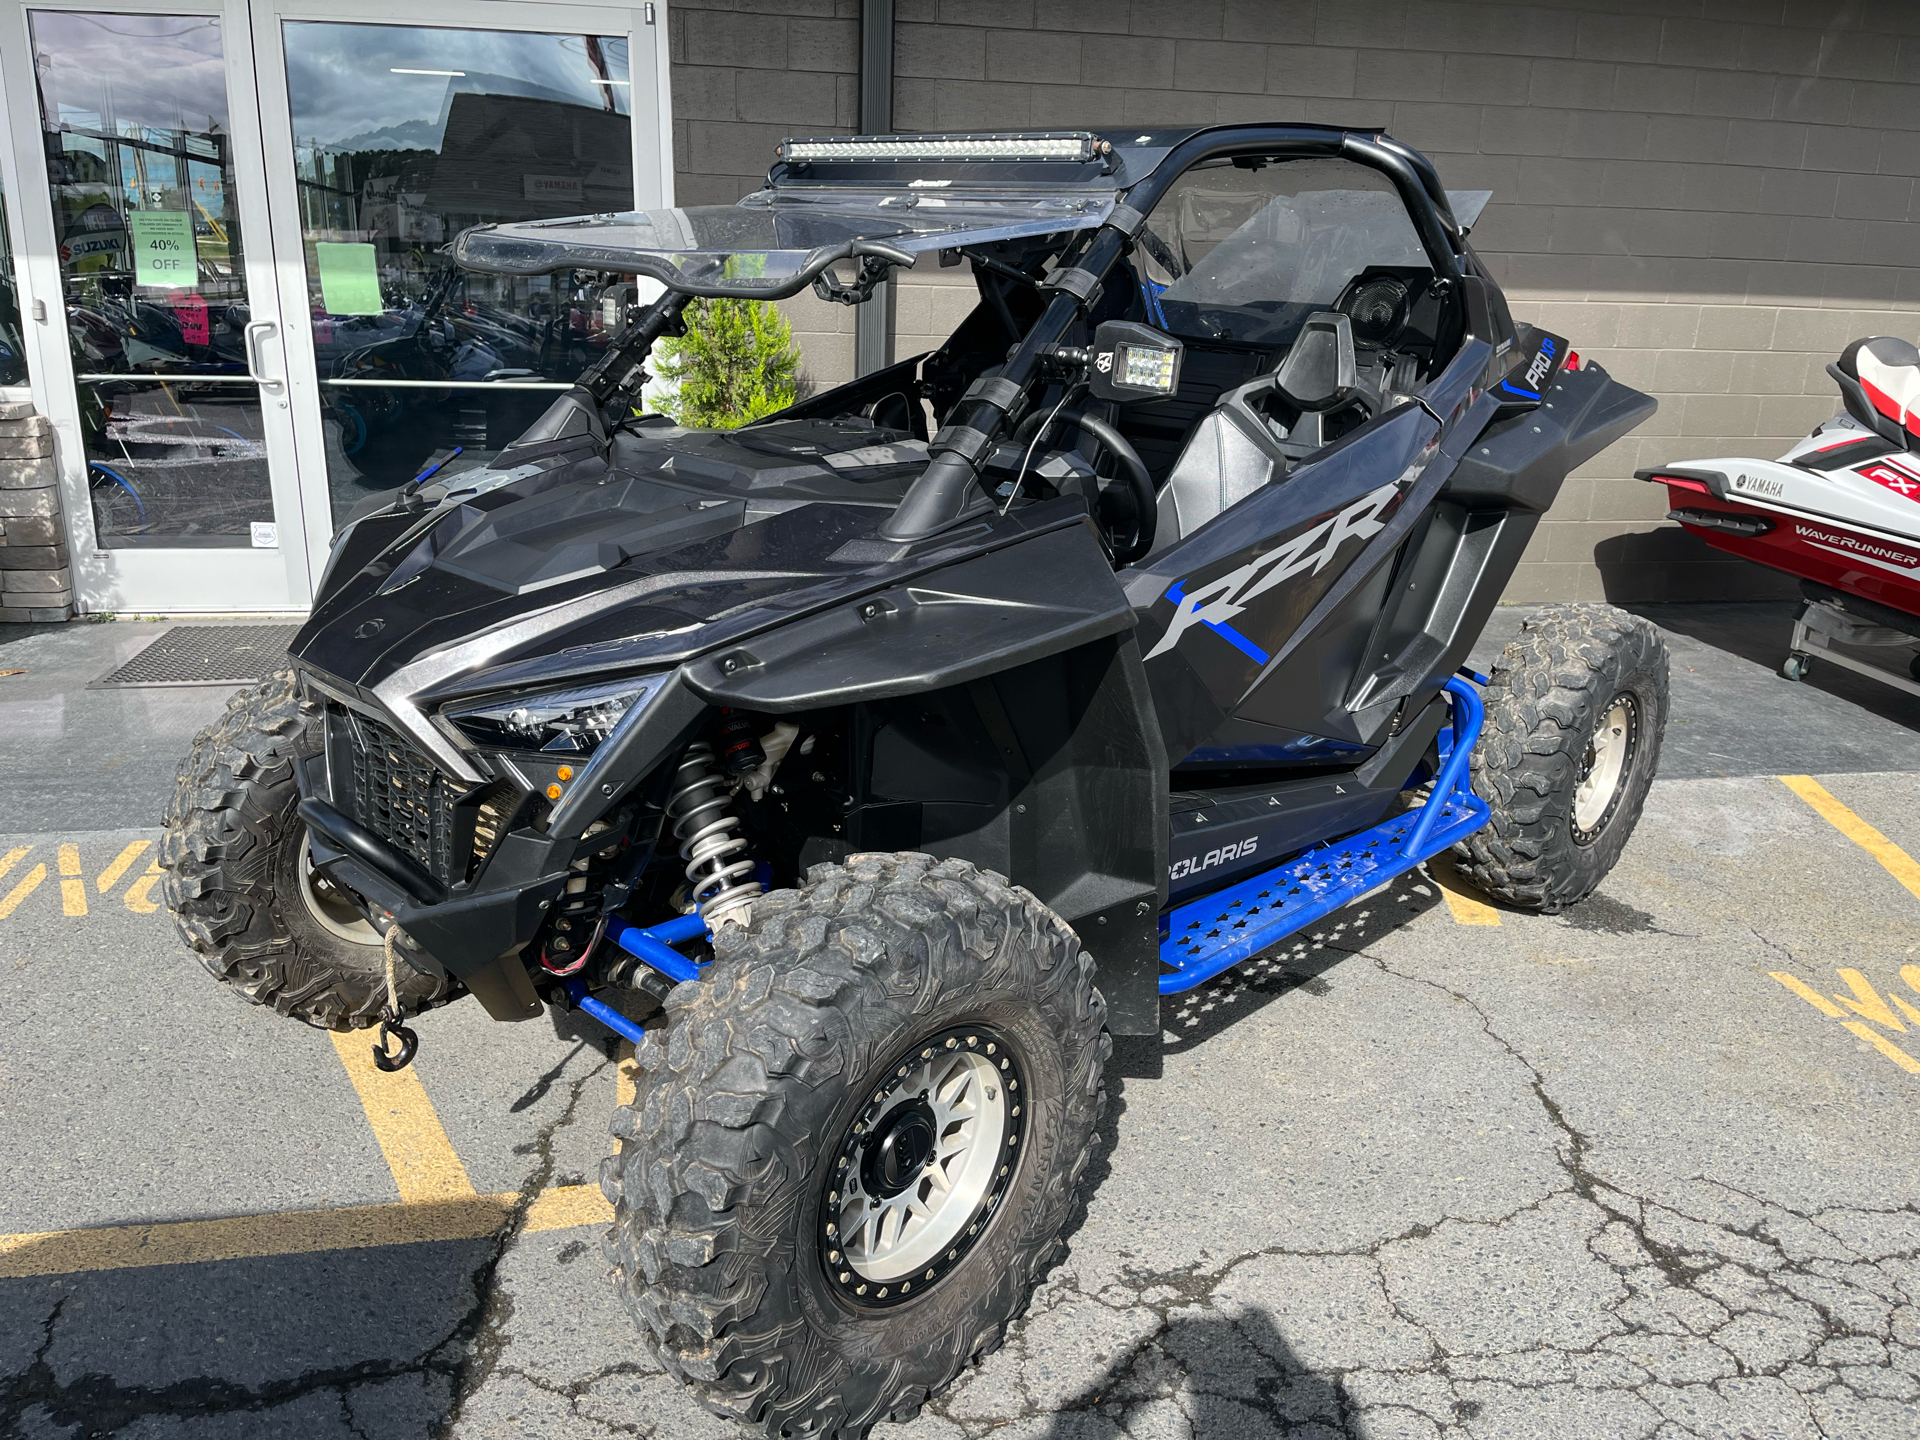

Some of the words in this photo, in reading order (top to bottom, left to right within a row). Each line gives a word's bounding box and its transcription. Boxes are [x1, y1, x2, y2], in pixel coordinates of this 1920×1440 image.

[72, 238, 122, 256] SUZUKI
[149, 239, 180, 251] 40%
[152, 258, 180, 270] OFF
[1746, 475, 1784, 498] YAMAHA
[1869, 467, 1918, 495] FX
[1142, 482, 1400, 662] RZR
[1168, 835, 1259, 881] OLARIS
